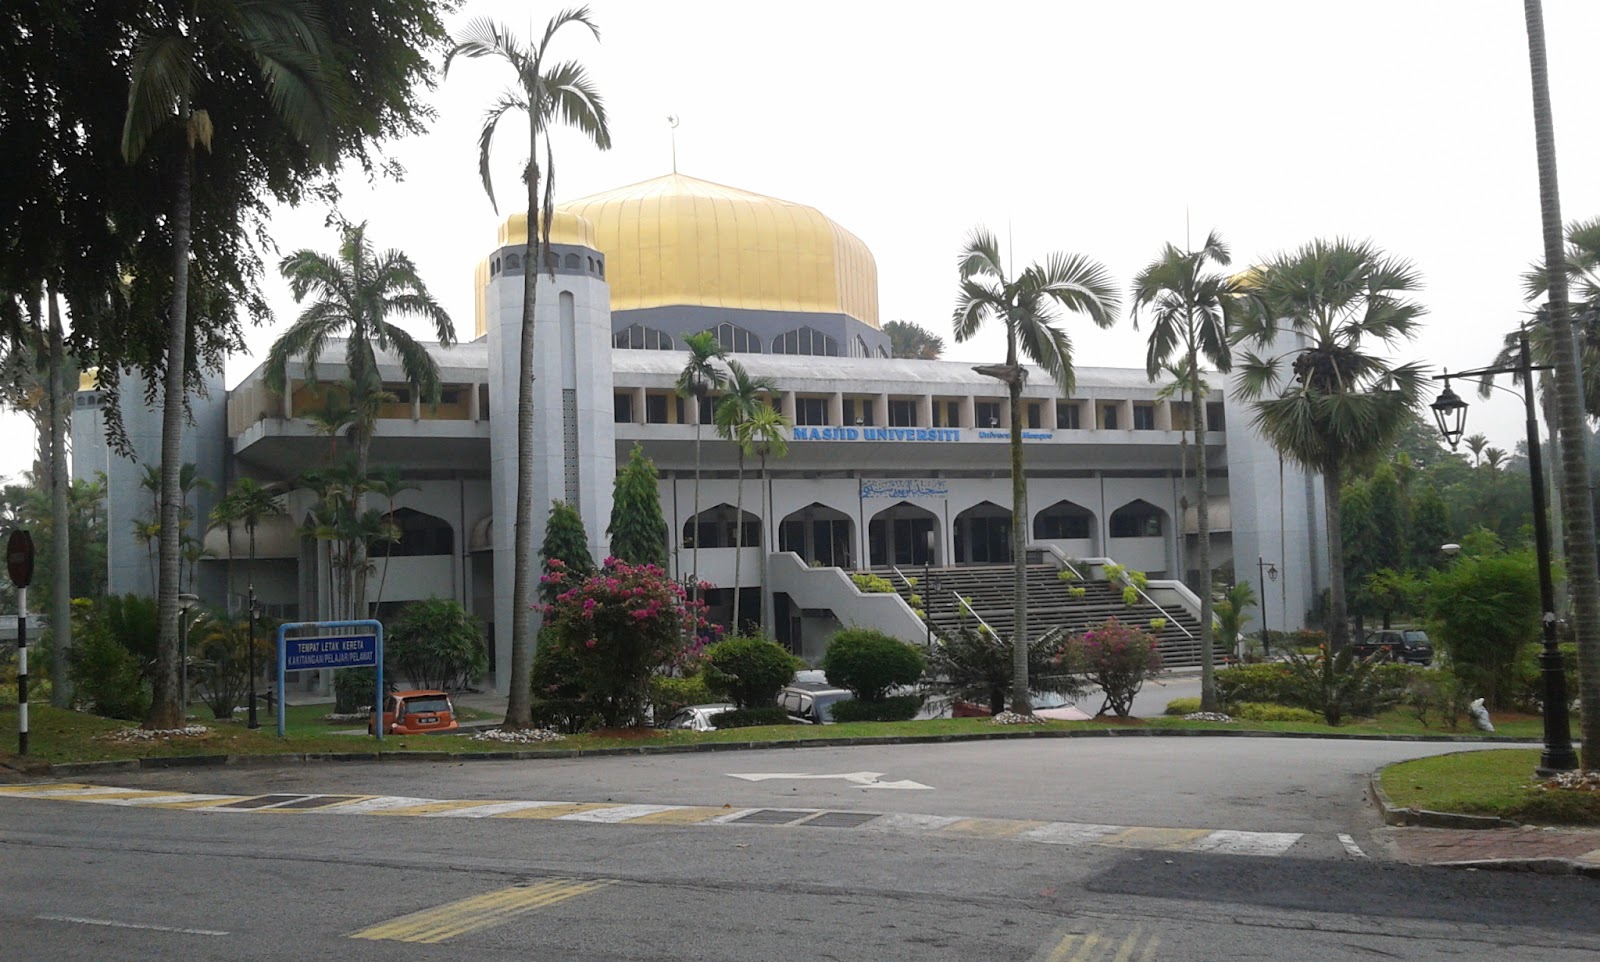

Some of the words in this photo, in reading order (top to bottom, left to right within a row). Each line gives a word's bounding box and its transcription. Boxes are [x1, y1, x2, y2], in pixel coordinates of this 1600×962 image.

[793, 427, 859, 440] MASJID
[863, 428, 960, 441] UNIVERSITI
[298, 642, 319, 653] TEMPAT
[321, 641, 339, 651] LETAK
[342, 640, 364, 650] KERETA
